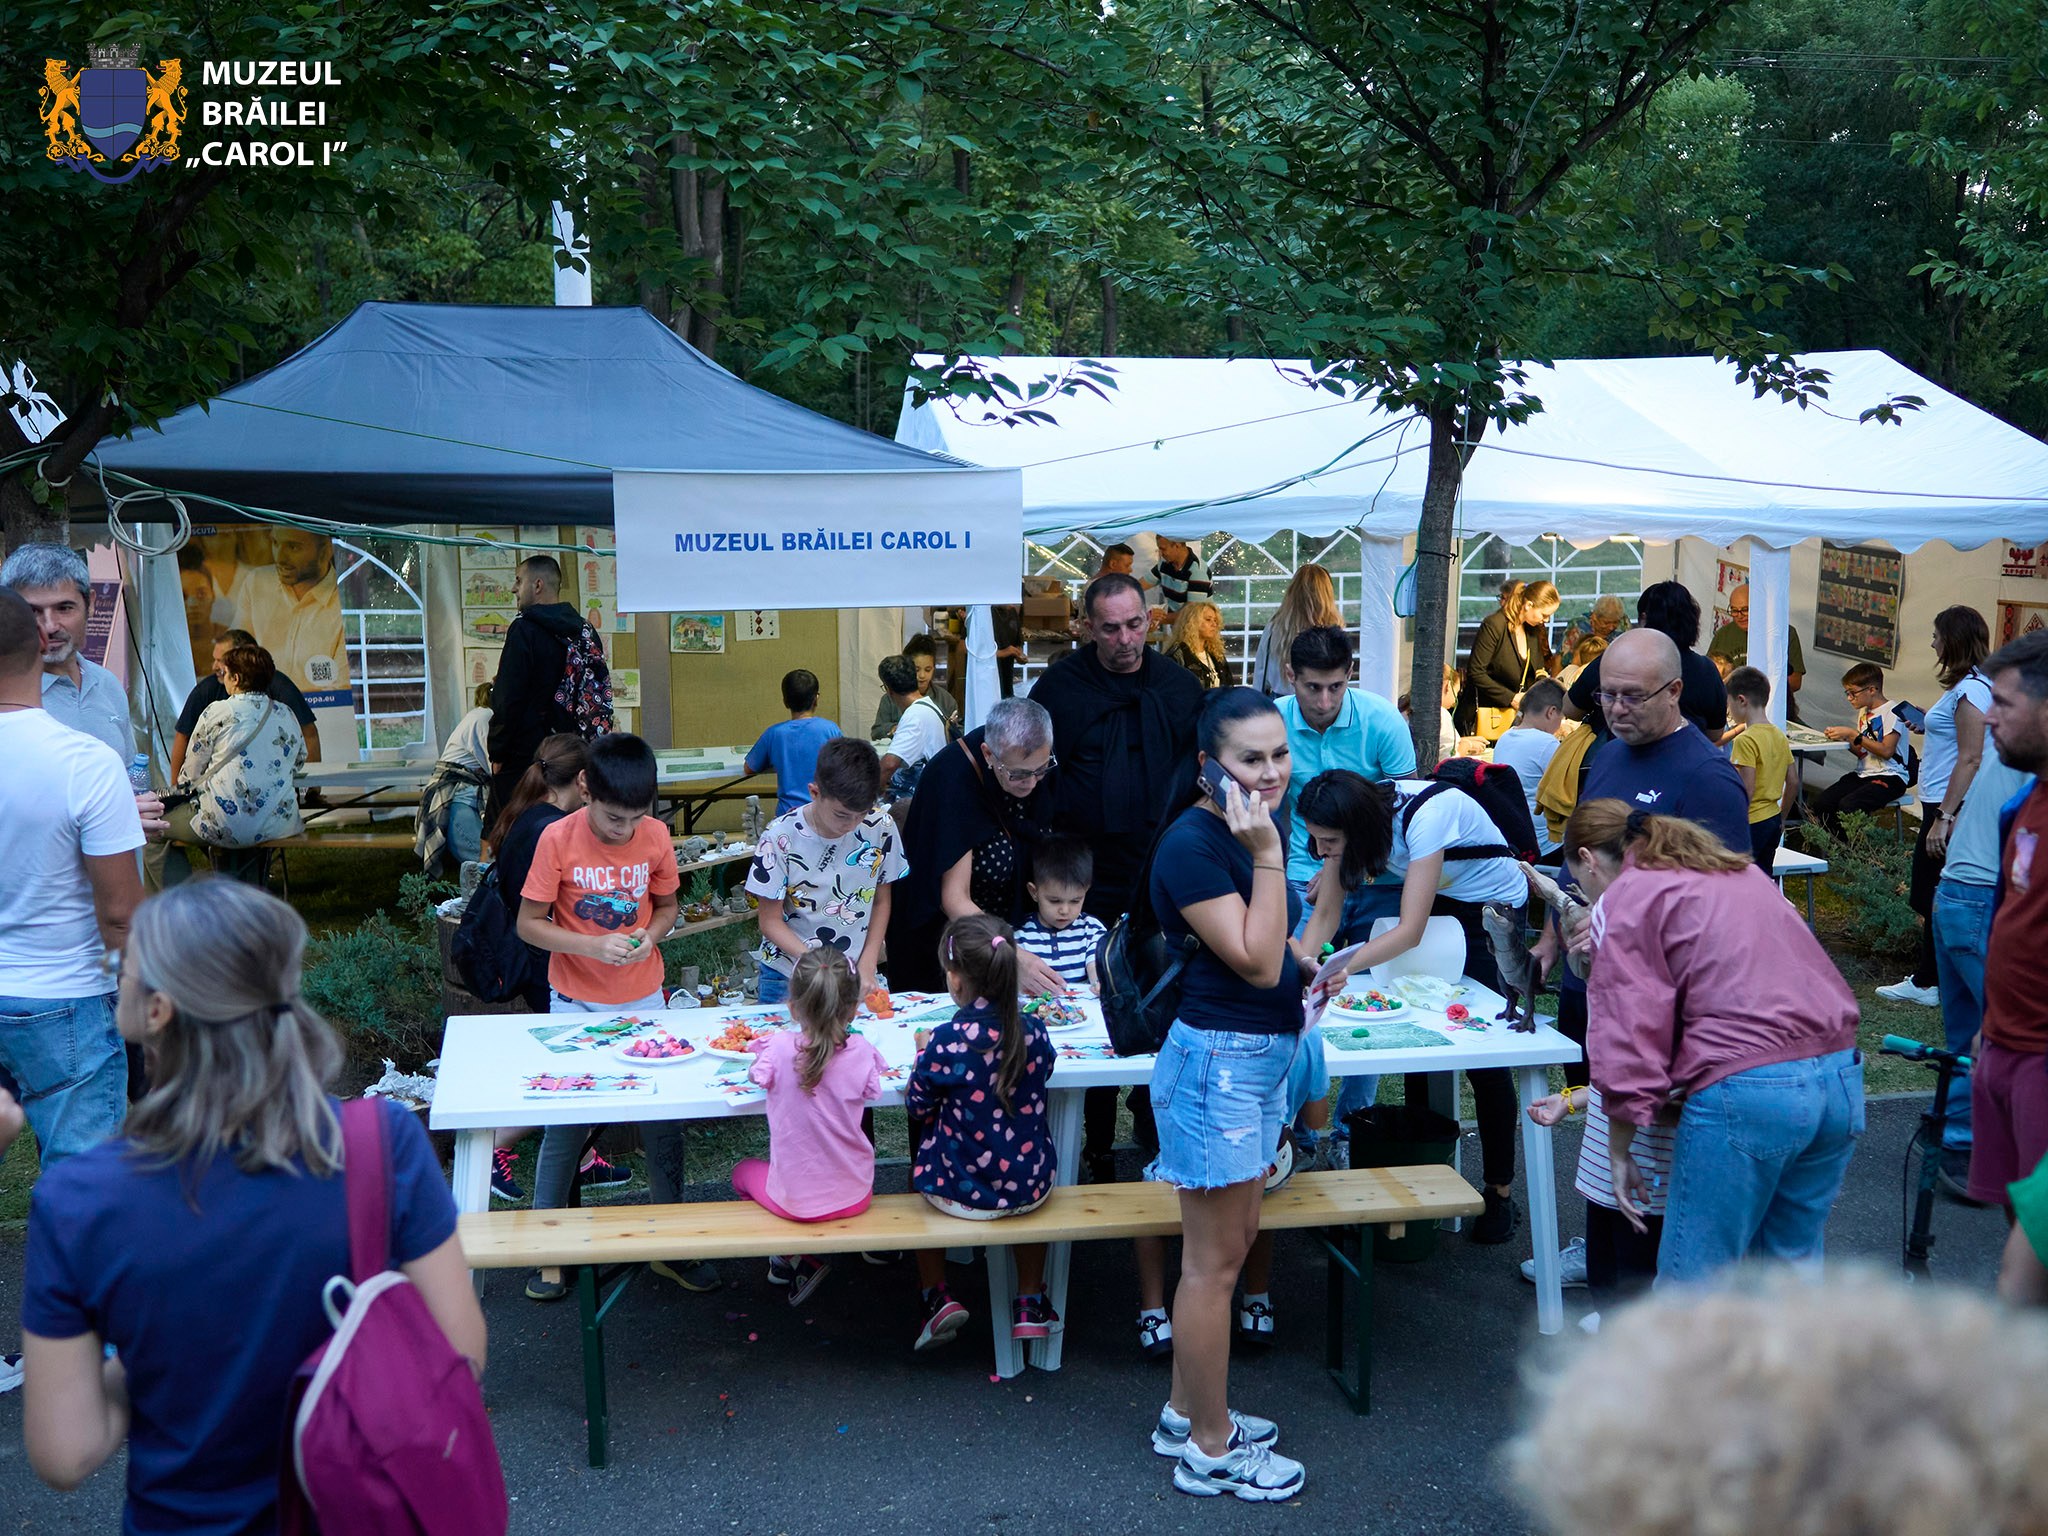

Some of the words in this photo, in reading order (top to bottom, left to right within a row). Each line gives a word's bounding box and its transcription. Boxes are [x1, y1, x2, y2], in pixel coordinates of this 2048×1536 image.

[674, 532, 775, 553] MUZEUL
[781, 527, 873, 551] BRĂILEI
[880, 530, 958, 550] CAROL
[964, 530, 971, 549] I
[573, 866, 616, 891] RACE
[620, 861, 650, 889] CAR
